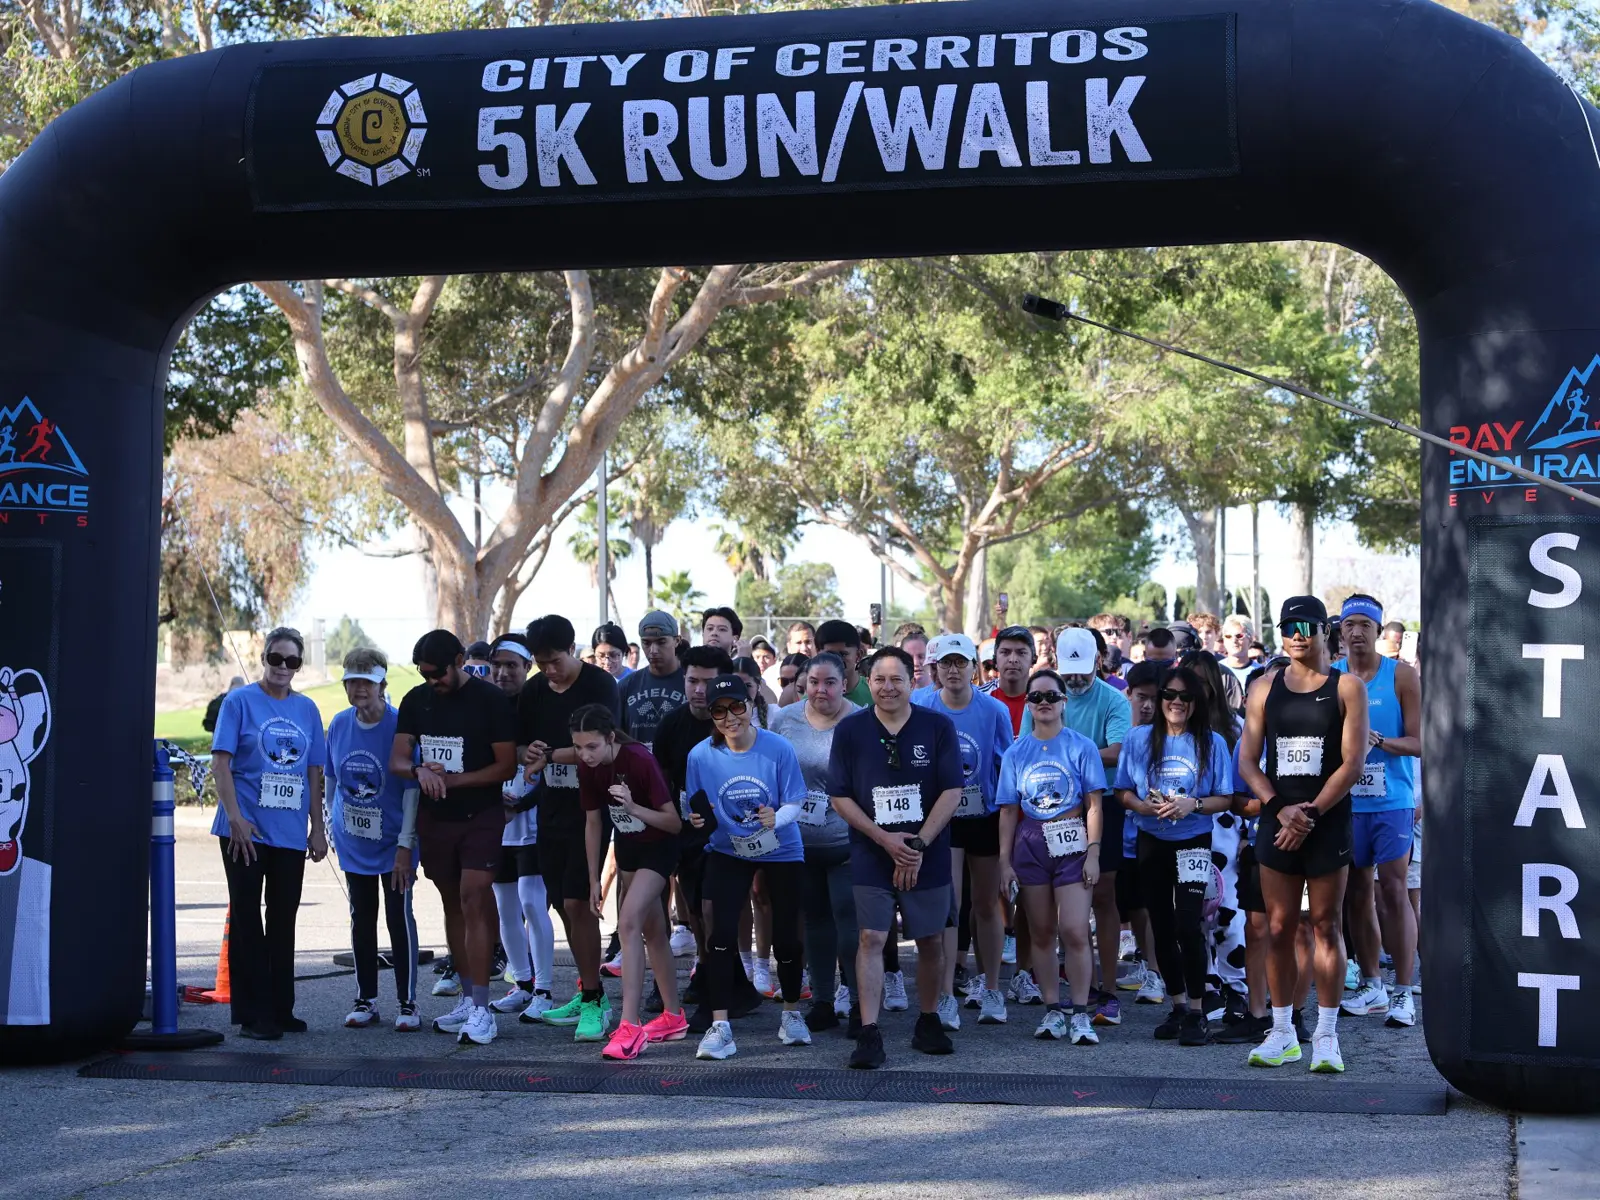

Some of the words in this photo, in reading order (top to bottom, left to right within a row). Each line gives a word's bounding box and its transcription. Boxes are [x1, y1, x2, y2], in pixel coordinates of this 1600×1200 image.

[481, 53, 646, 92] CITY
[663, 46, 756, 83] OF
[775, 26, 1149, 77] CERRITOS
[350, 102, 361, 116] CITY
[477, 102, 598, 190] 5K
[622, 75, 1153, 183] RUN/WALK
[416, 168, 431, 177] SM
[1449, 420, 1525, 456] RAY
[1449, 453, 1600, 485] ENDURA
[1448, 487, 1584, 508] EVE
[715, 681, 732, 689] YOU
[431, 747, 453, 761] 170
[1287, 749, 1311, 763] 505
[550, 763, 569, 777] 154
[272, 784, 294, 798] 109
[1513, 532, 1587, 1047] START
[886, 797, 910, 812] 148
[351, 816, 371, 829] 108
[611, 814, 633, 824] 540
[1056, 829, 1080, 844] 162
[747, 839, 763, 851] 91
[1188, 858, 1209, 872] 347
